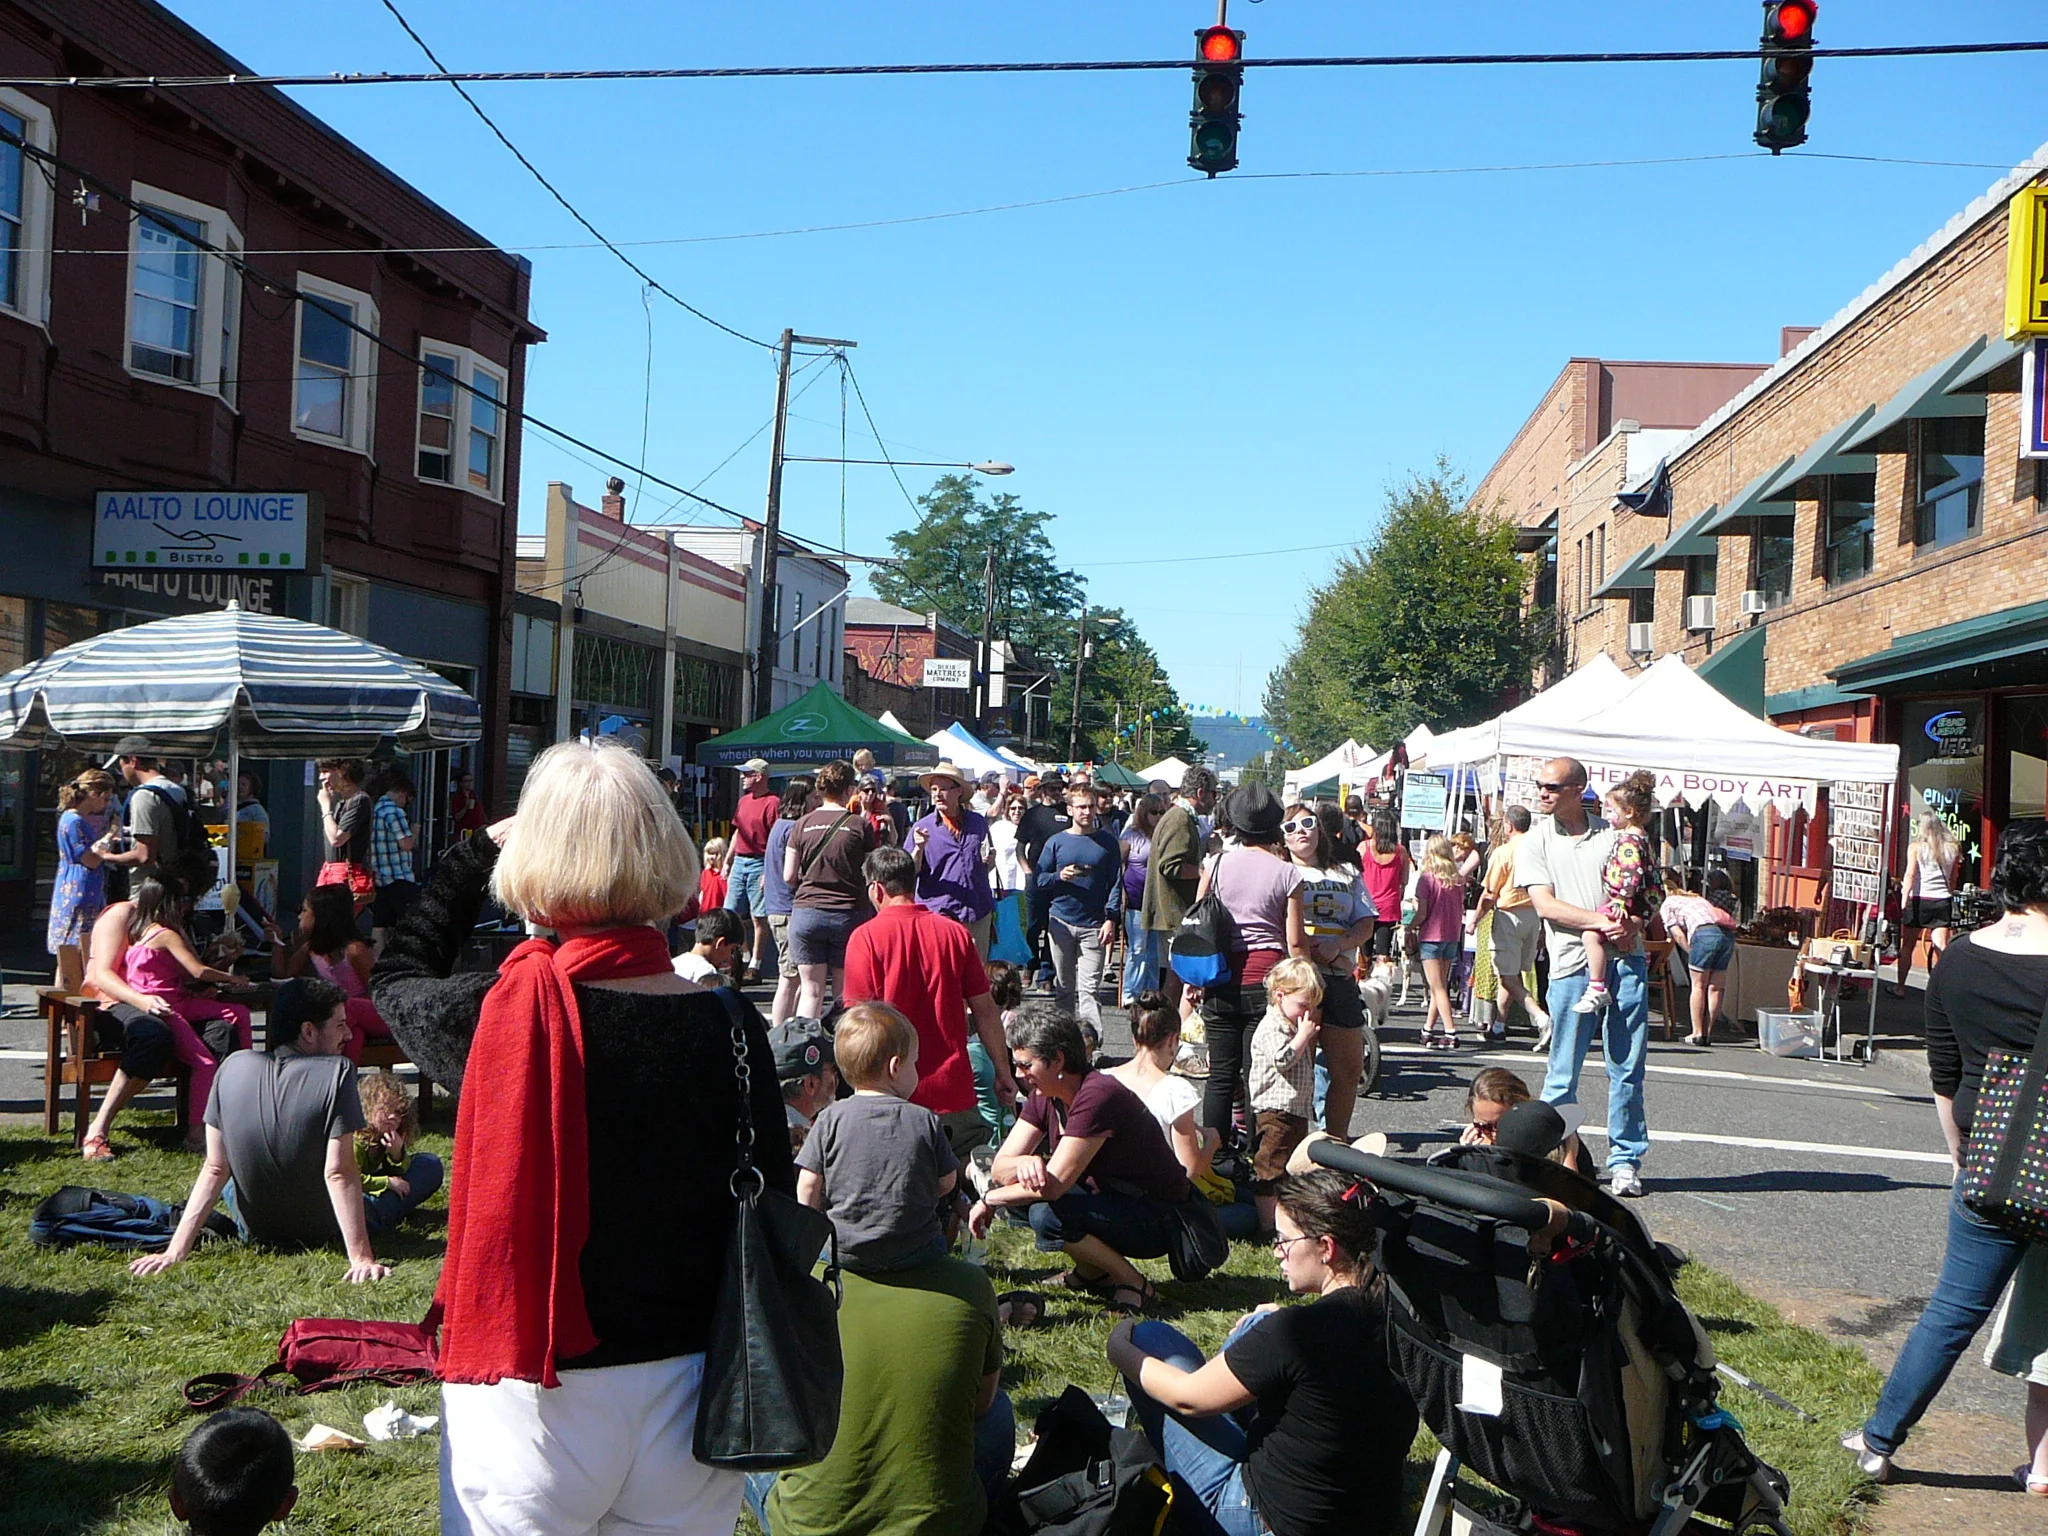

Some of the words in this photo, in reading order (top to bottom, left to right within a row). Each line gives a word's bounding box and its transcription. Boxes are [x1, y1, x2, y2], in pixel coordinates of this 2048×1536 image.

[103, 496, 182, 520] AALTO
[193, 497, 294, 521] LOUNGE
[169, 552, 224, 563] BISTRO
[188, 573, 273, 613] LOUNGE
[926, 669, 967, 678] MATTRESS
[719, 748, 758, 761] wheels
[760, 748, 790, 759] when
[793, 749, 813, 761] you
[815, 748, 844, 758] want
[1588, 765, 1675, 788] HEA
[1683, 774, 1749, 794] BODY
[1757, 780, 1807, 800] ART
[1923, 787, 1961, 814] enjoy
